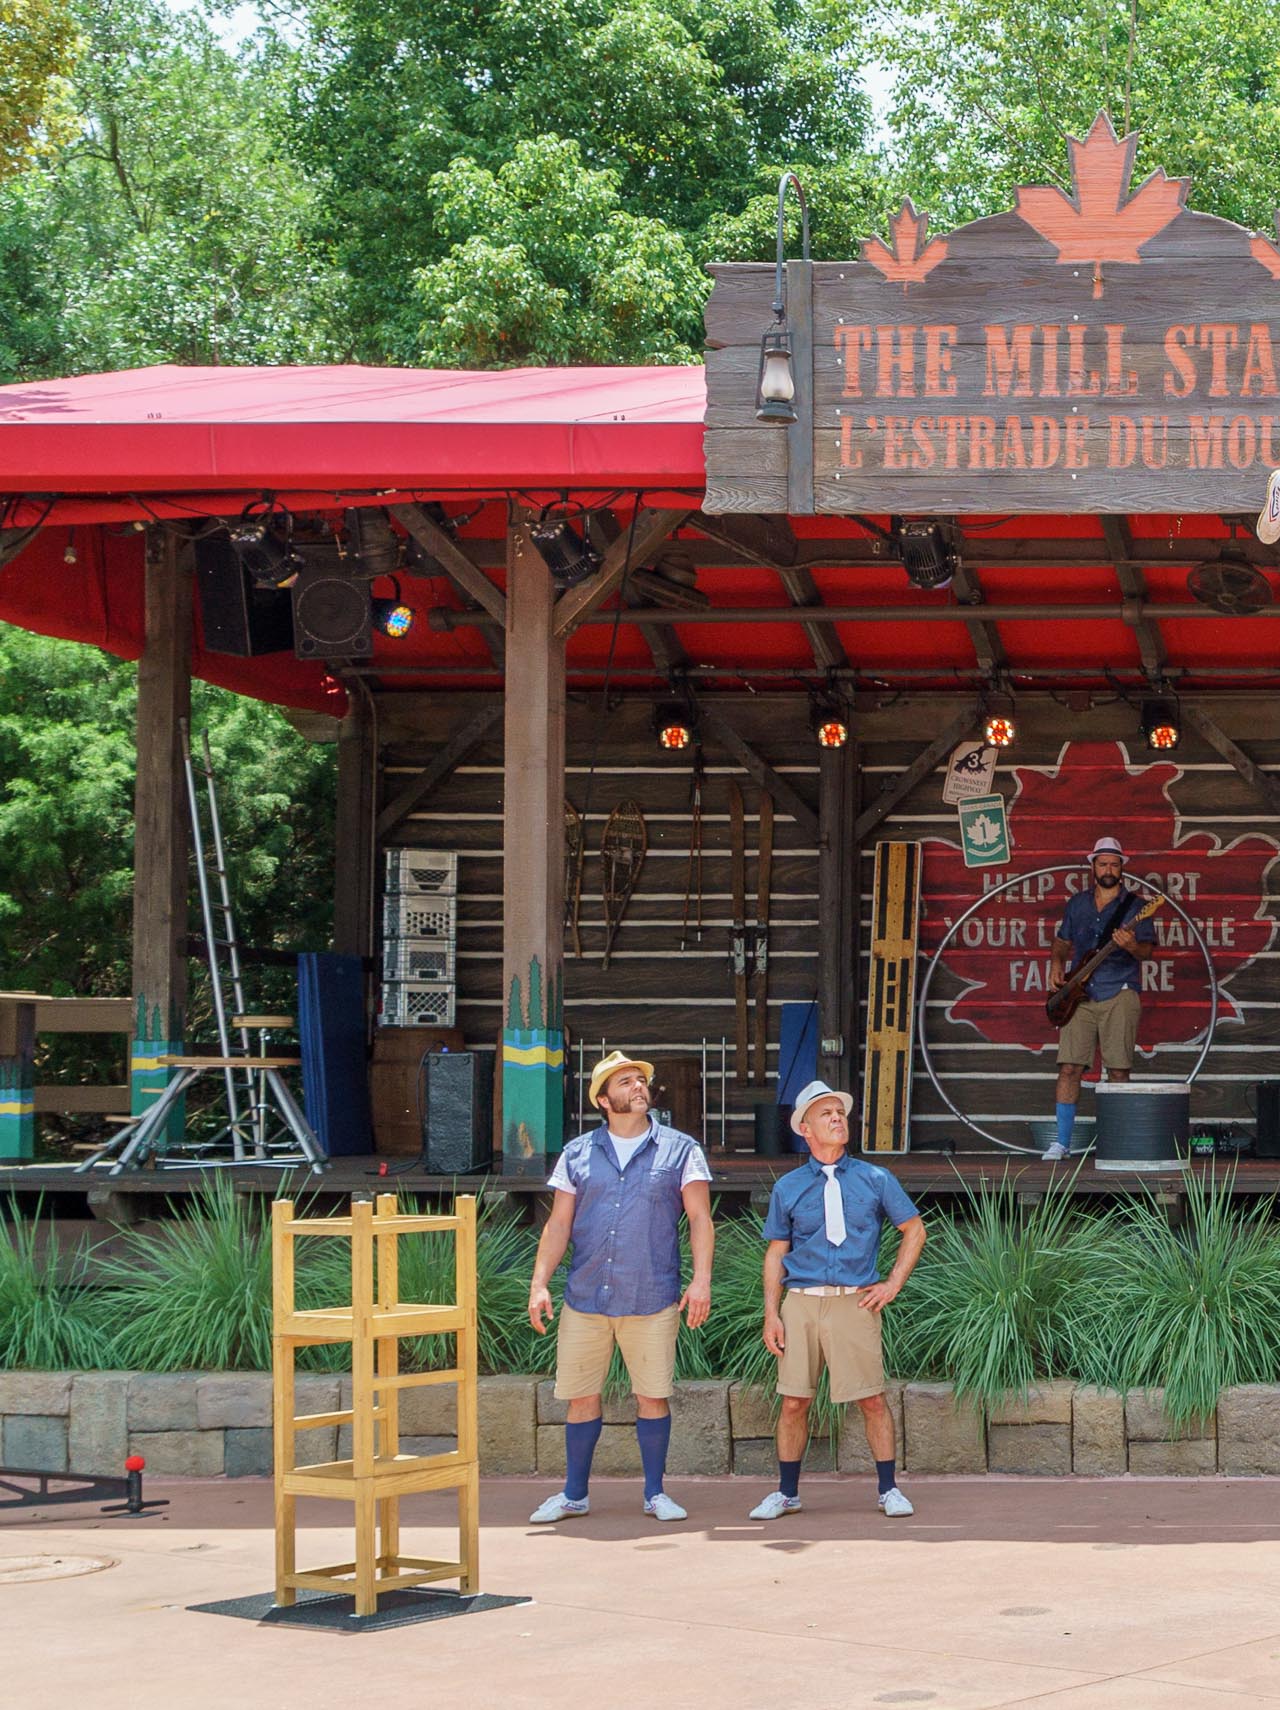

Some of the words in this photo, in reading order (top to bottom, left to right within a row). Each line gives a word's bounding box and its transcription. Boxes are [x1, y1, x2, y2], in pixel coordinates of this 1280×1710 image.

[833, 324, 958, 397] THE
[982, 324, 1139, 397] MILL
[1107, 415, 1169, 469] DU
[967, 752, 979, 768] 3
[980, 822, 987, 839] 1
[982, 872, 1055, 903] HELP
[943, 917, 1027, 947] YOUR
